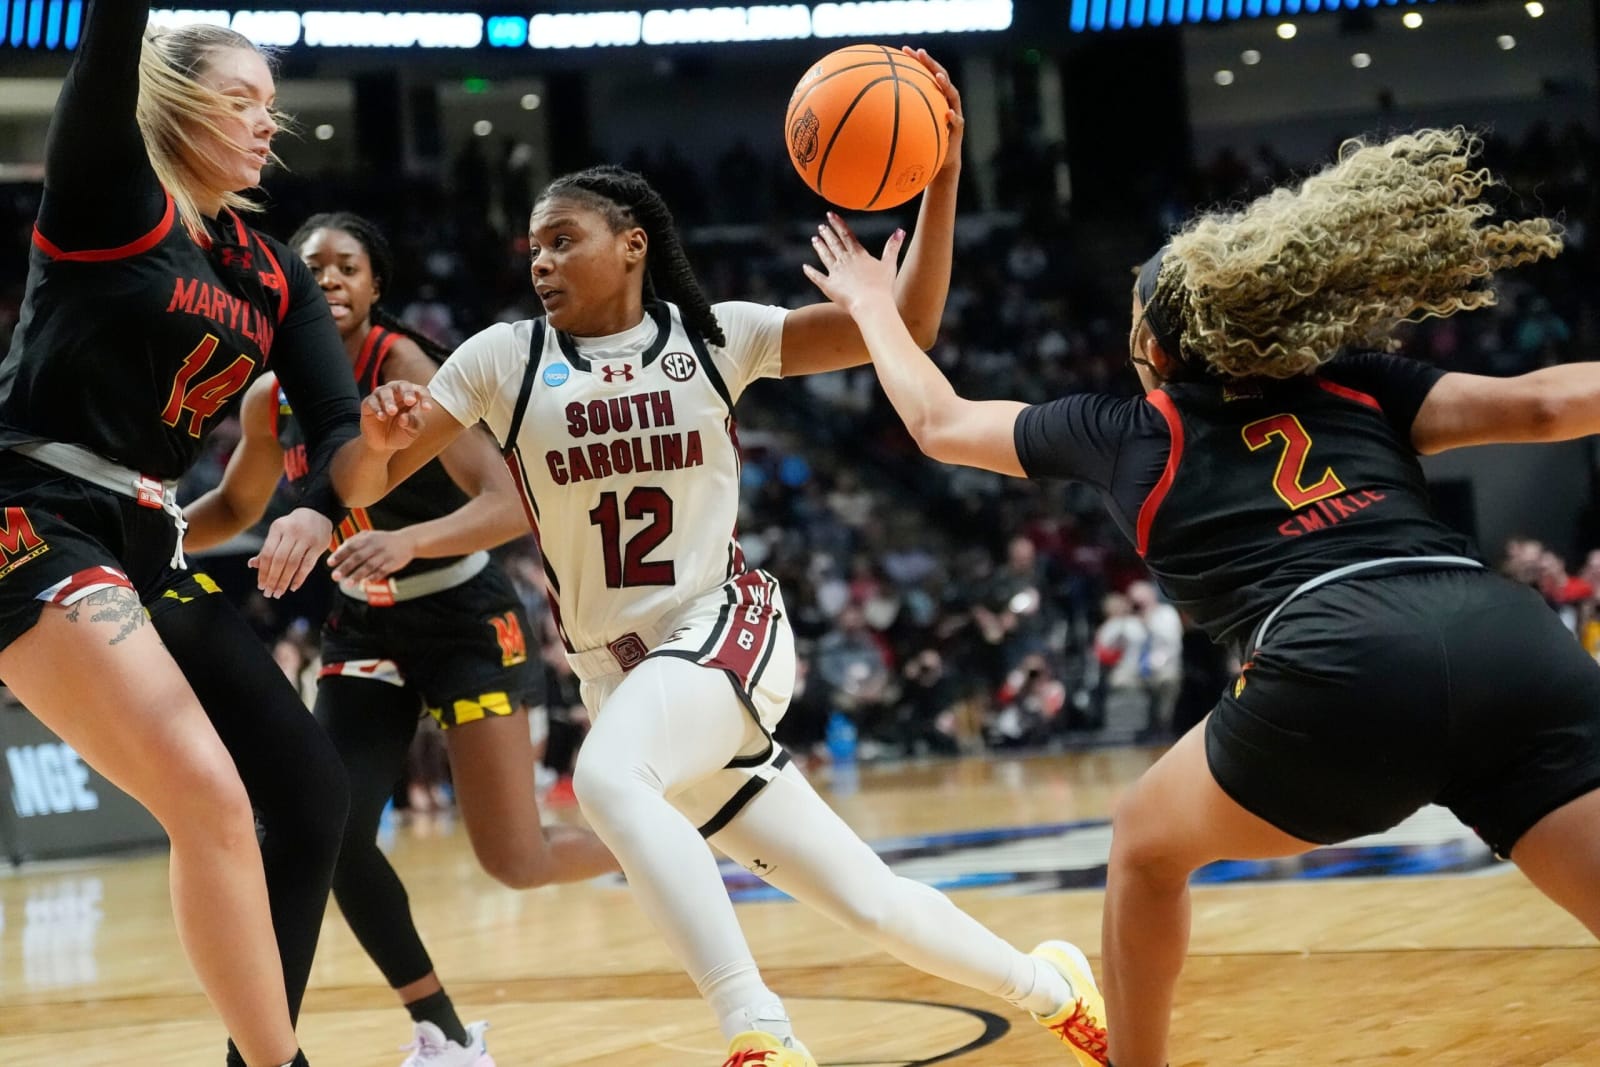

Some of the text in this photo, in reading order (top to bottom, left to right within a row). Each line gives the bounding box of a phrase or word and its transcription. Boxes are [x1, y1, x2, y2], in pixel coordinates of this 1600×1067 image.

[161, 333, 256, 439] 14
[663, 353, 693, 379] SEC
[565, 390, 675, 438] SOUTH
[545, 430, 704, 486] CAROLINA
[1241, 413, 1347, 511] 2
[589, 486, 677, 589] 12
